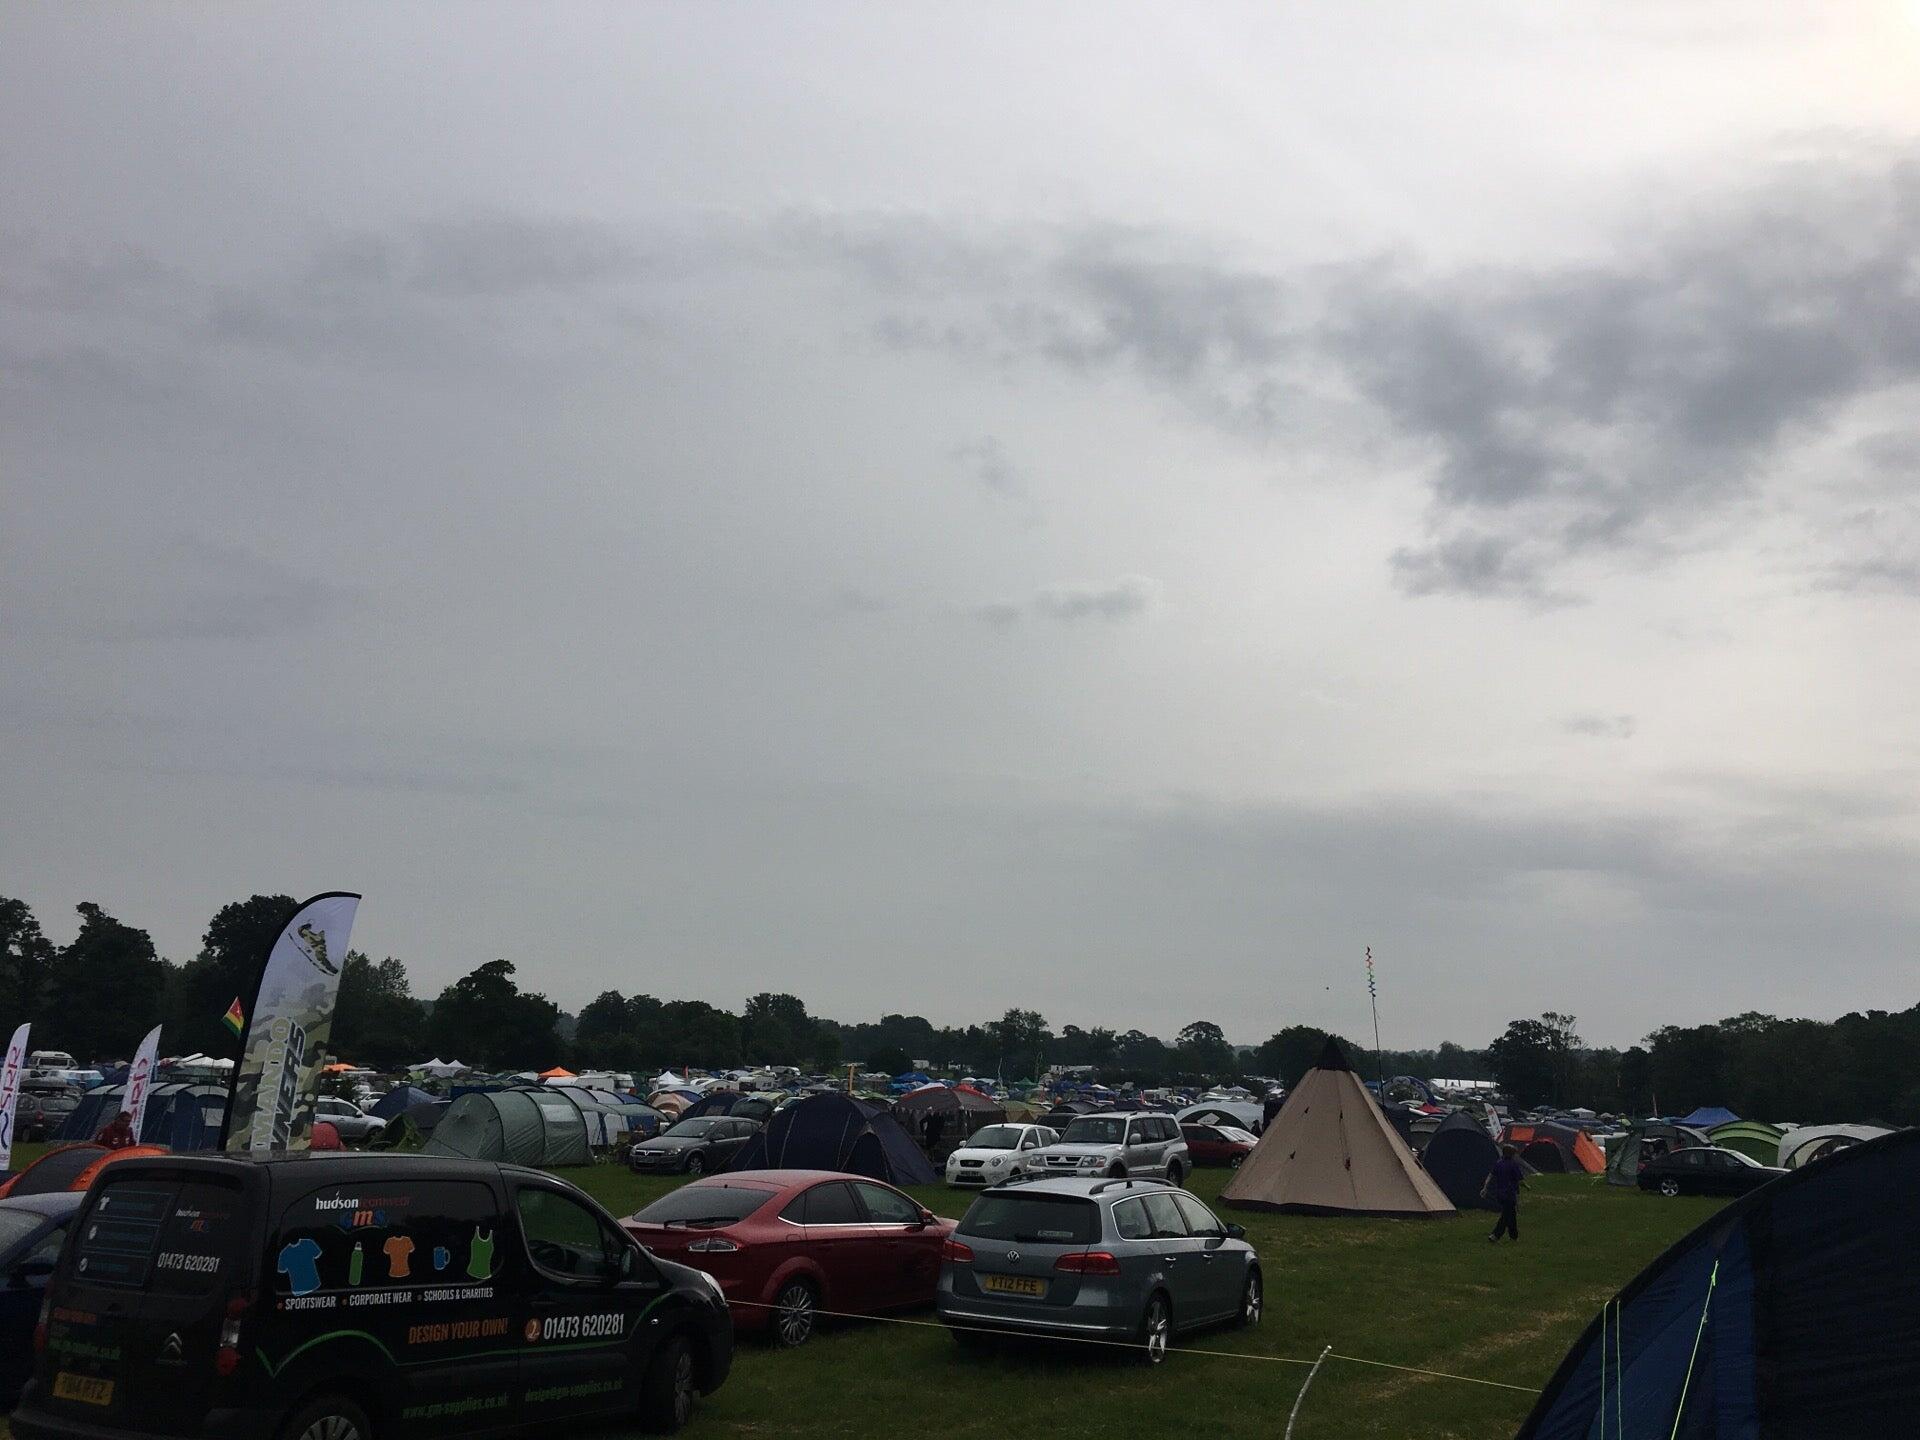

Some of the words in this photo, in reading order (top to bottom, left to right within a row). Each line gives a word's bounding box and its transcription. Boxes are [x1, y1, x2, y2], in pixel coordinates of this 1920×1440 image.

[315, 1192, 360, 1210] hudson
[157, 1252, 183, 1270] 01473
[185, 1255, 222, 1273] 620281
[349, 1292, 391, 1307] CORPORATE
[392, 1291, 413, 1306] WEAR
[423, 1288, 454, 1302] SCHOOLS
[461, 1286, 494, 1300] CHARITIES
[285, 1296, 336, 1311] SPORTSWEAR
[407, 1323, 449, 1345] DESIGN
[451, 1320, 480, 1341] YOUR
[481, 1317, 510, 1337] OWN!
[544, 1315, 579, 1340] 01473
[581, 1313, 625, 1338] 620281
